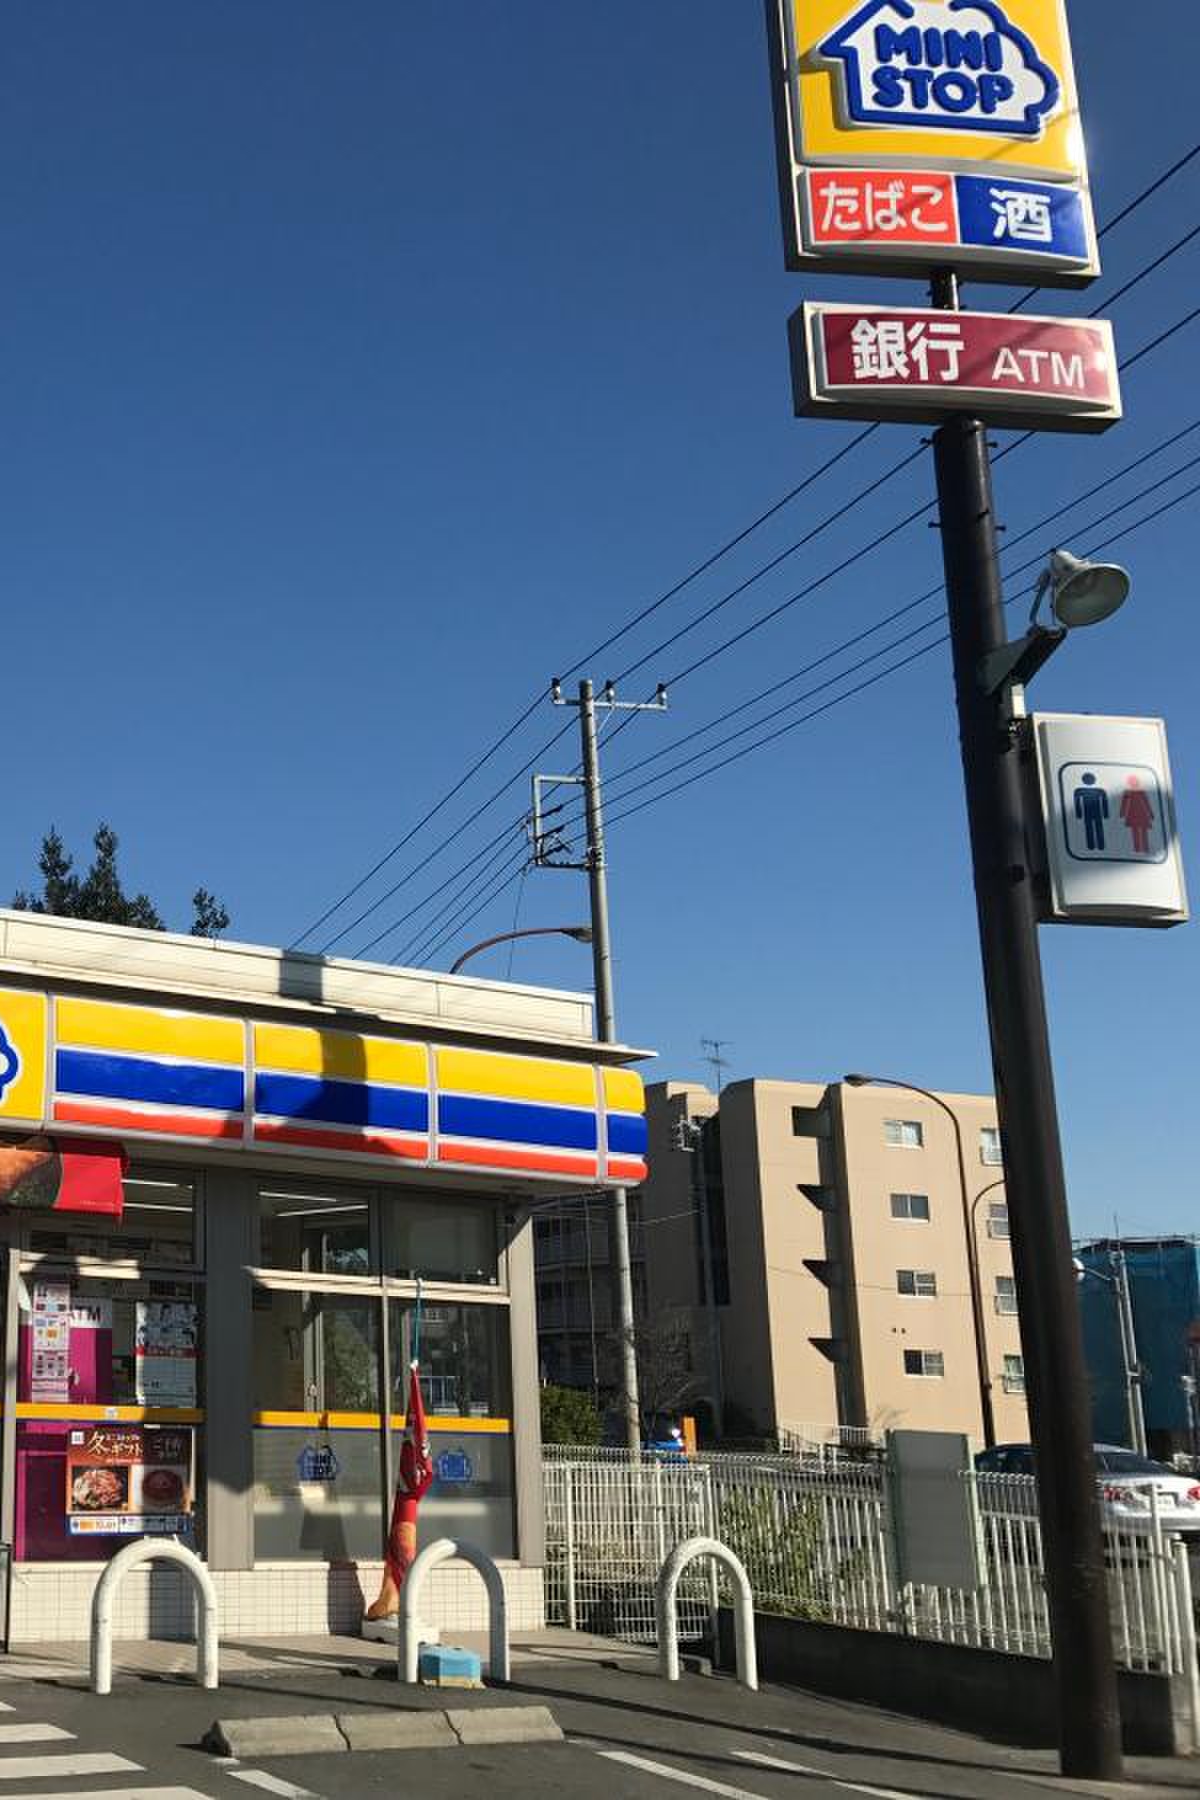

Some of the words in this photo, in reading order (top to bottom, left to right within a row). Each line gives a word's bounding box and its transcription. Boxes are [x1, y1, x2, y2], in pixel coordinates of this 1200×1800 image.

[874, 24, 1003, 70] MINI
[871, 66, 1013, 113] STOP
[818, 181, 948, 233] たばこ
[989, 188, 1052, 241] 酒
[850, 320, 964, 381] 銀行
[992, 347, 1084, 389] ATM
